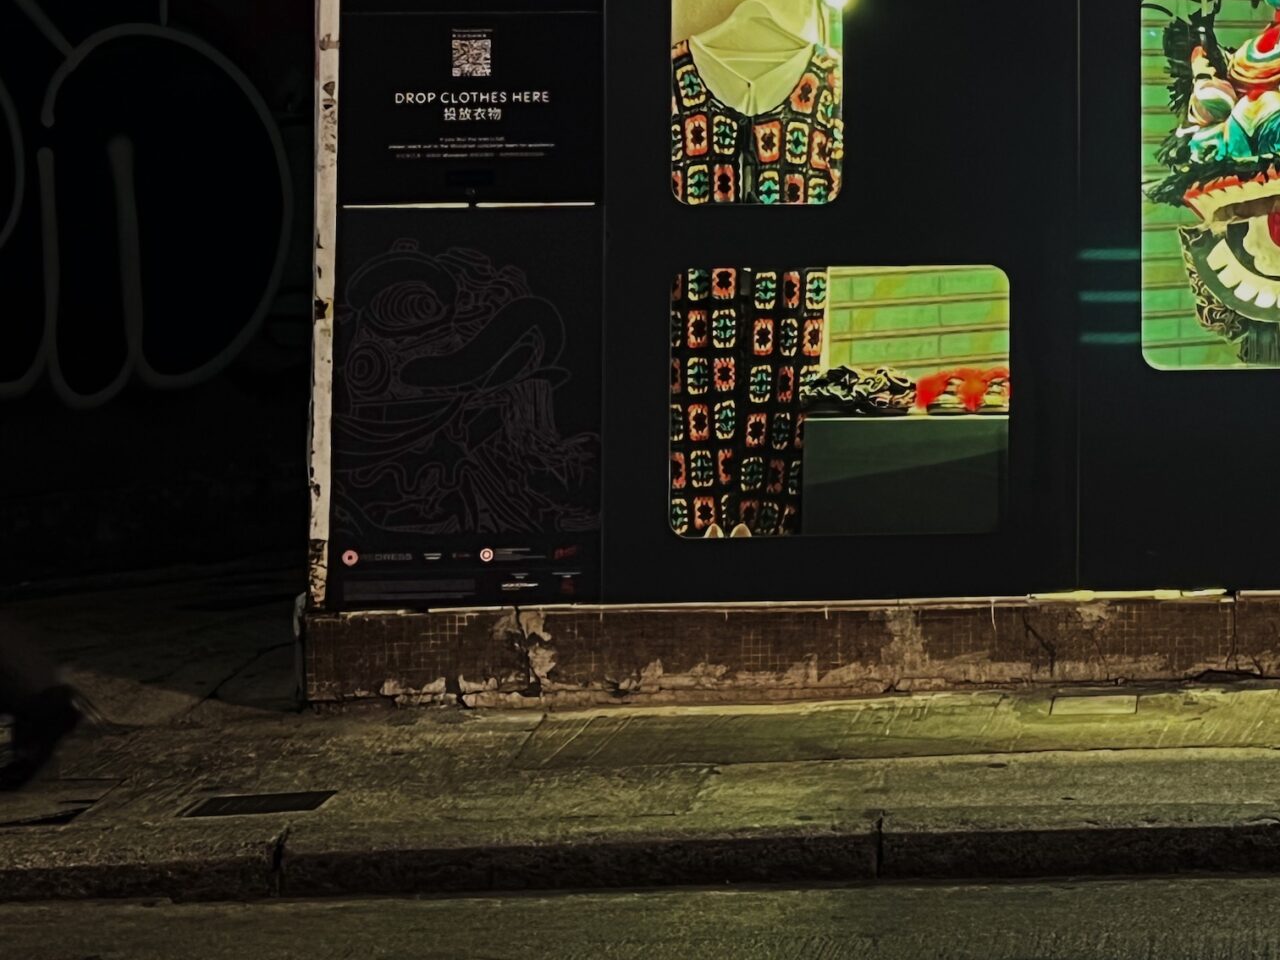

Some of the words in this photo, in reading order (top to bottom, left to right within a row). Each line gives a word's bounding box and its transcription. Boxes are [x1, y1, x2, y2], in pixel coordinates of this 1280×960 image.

[394, 91, 437, 105] DROP
[439, 91, 508, 105] CLOTHES
[511, 91, 551, 105] HERE
[442, 106, 503, 122] 投放衣物
